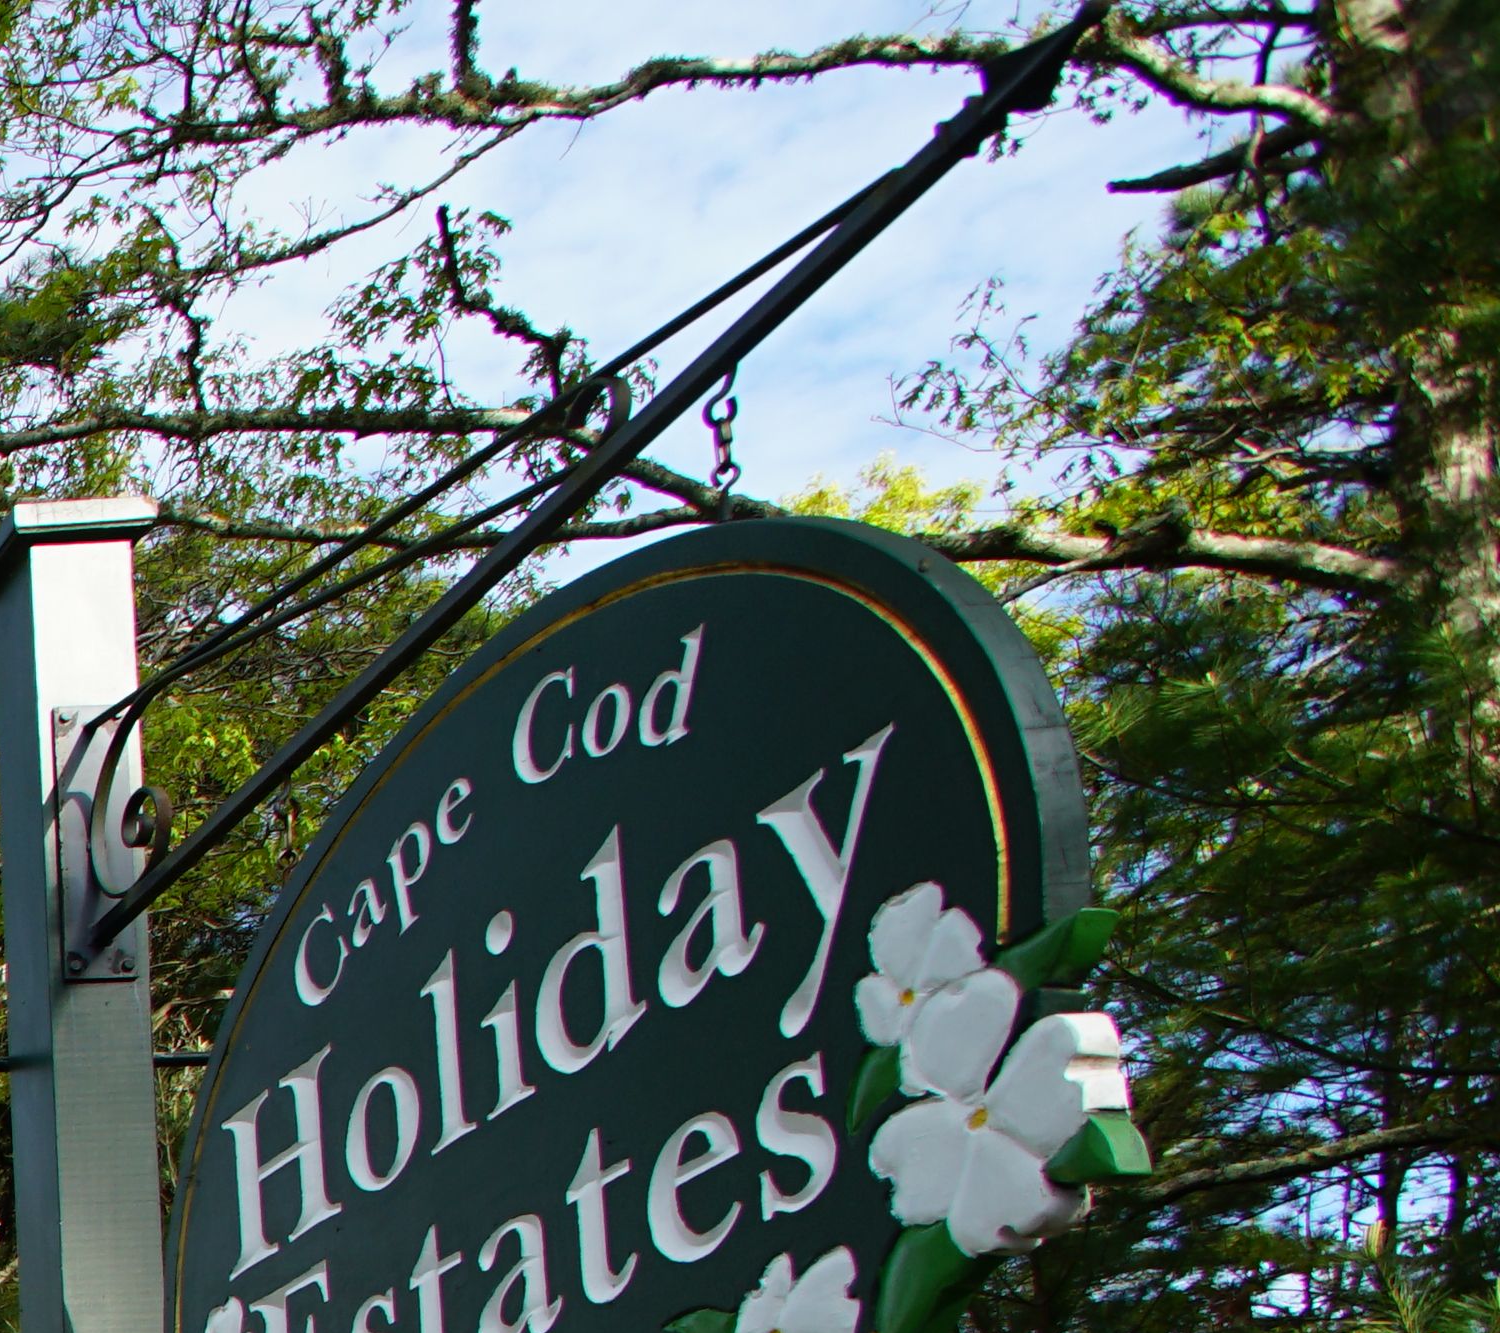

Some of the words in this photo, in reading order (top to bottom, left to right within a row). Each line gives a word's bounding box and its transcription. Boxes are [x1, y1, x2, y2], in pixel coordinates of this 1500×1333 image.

[222, 722, 895, 1281] Holiday
[295, 777, 474, 1005] Cape
[513, 623, 704, 784] Cod
